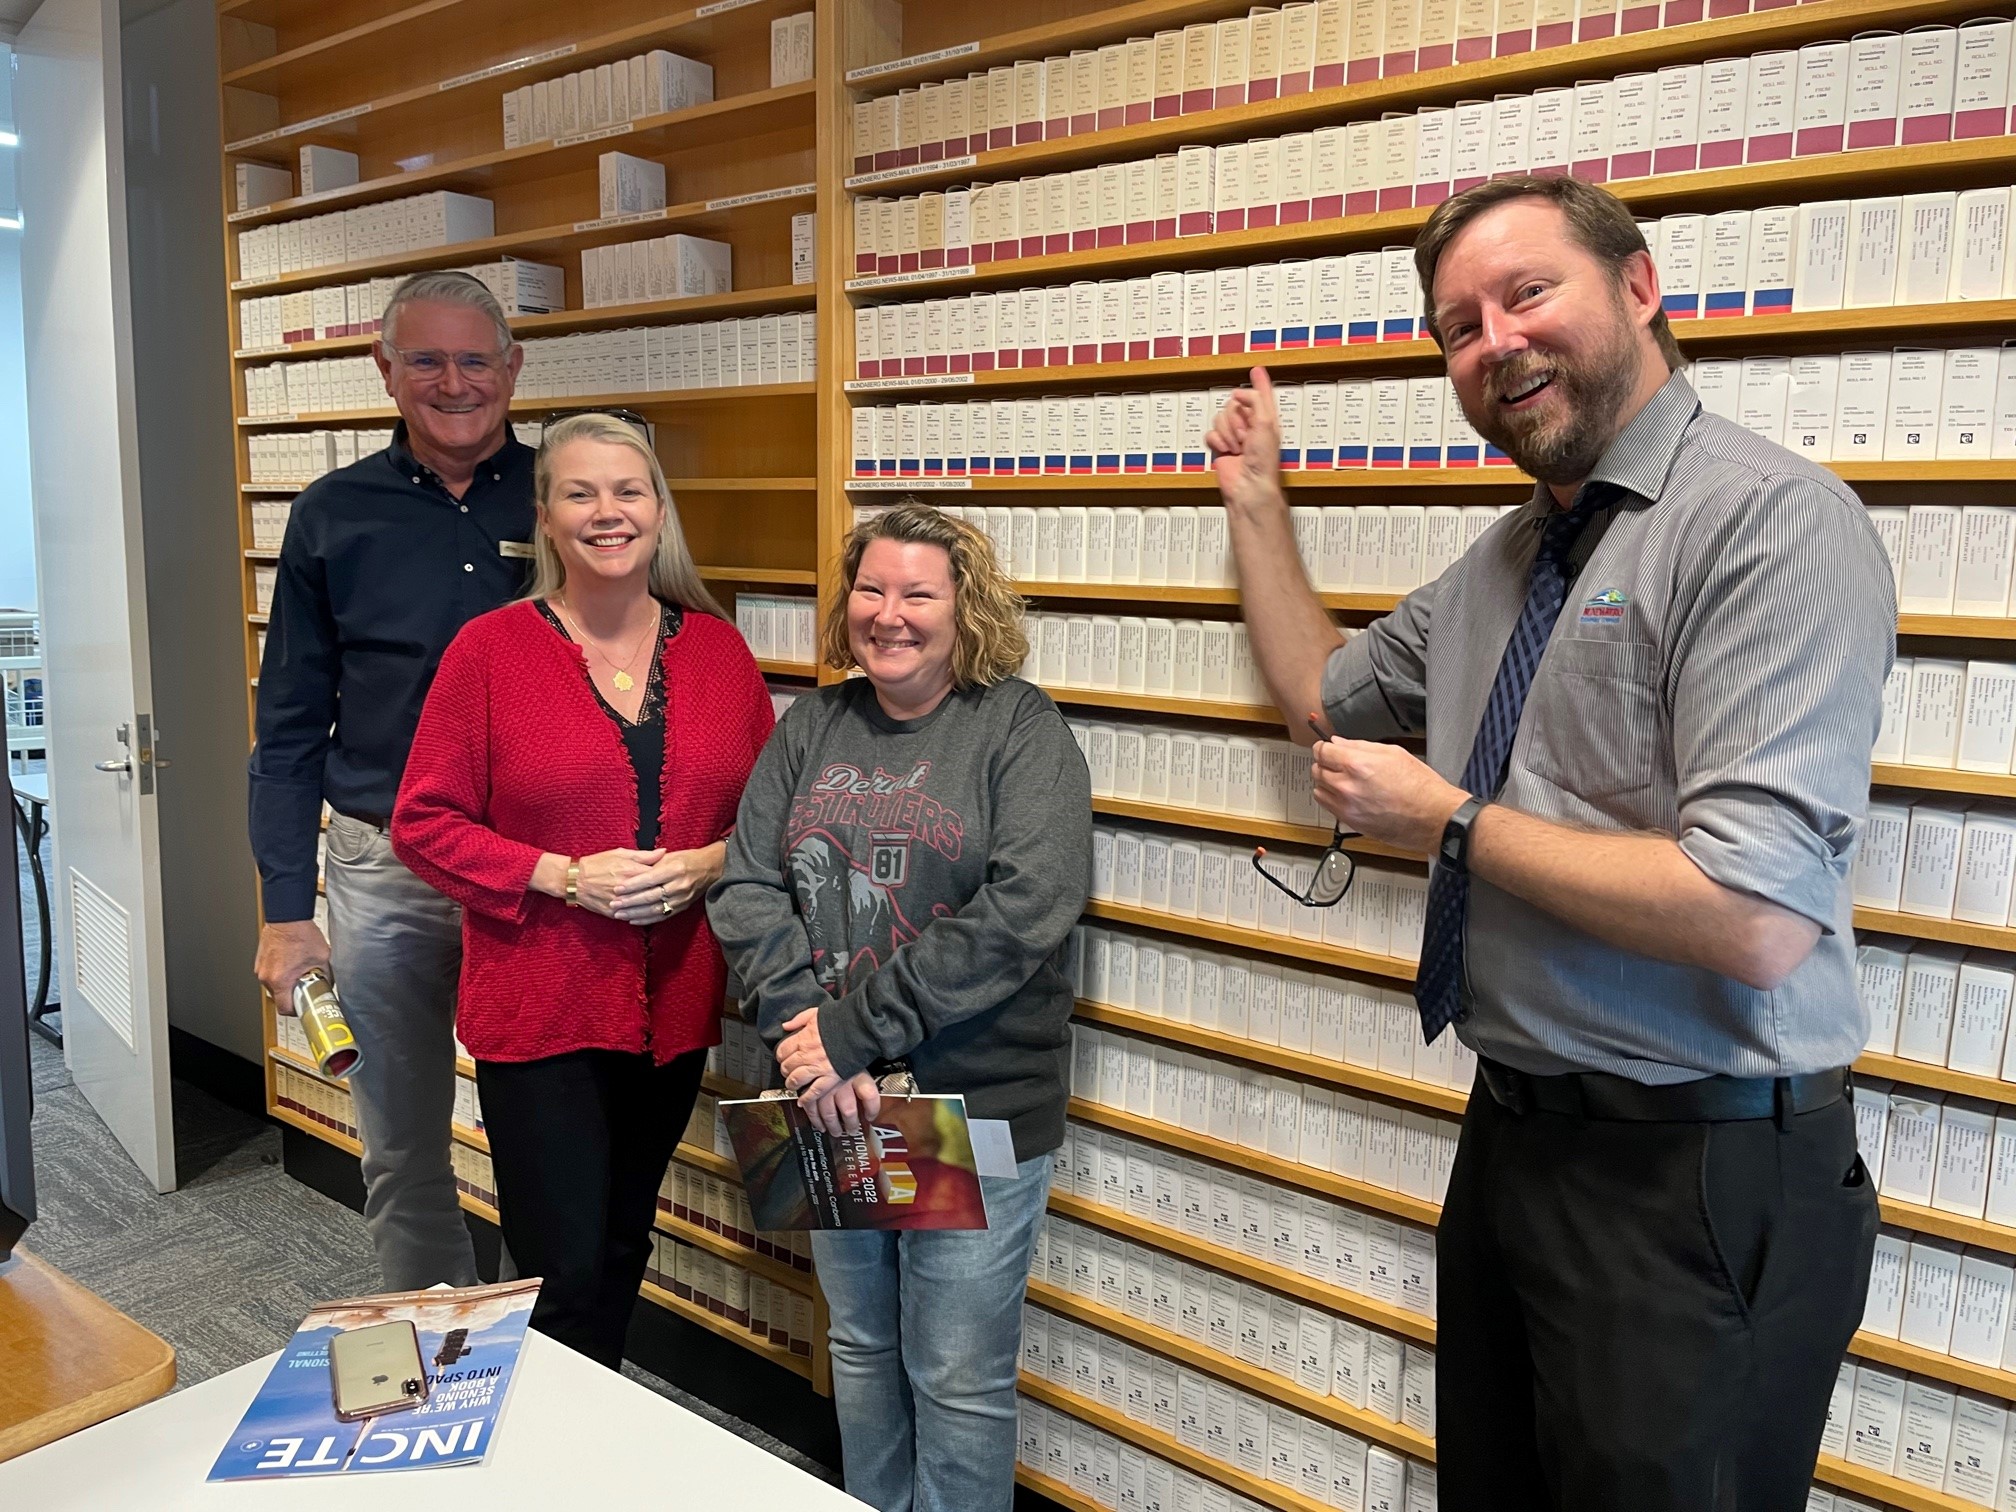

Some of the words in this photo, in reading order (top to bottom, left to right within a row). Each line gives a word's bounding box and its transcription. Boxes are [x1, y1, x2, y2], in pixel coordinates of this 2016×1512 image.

[850, 66, 882, 78] BUNDABERG
[884, 60, 912, 72] NEWS-MAIL
[850, 174, 881, 186] BUNDABERG
[882, 168, 910, 180] NEWS-MAIL
[850, 277, 882, 288] BUNDABERG
[882, 275, 910, 284] NEWS-MAIL
[850, 380, 882, 388] BUNDABERG
[882, 379, 910, 388] NEWS-MAIL
[911, 378, 938, 386] 01/01/2000
[788, 789, 963, 862] ESTROYERS
[875, 848, 902, 880] 81
[840, 1131, 864, 1204] ONFERENCE
[814, 1132, 828, 1170] Convention
[829, 1196, 842, 1227] Canberra
[862, 1177, 878, 1204] 2022
[288, 1358, 332, 1369] SIONAL
[426, 1372, 464, 1385] SPAC
[466, 1366, 502, 1380] INTO
[490, 1376, 499, 1385] A
[449, 1378, 486, 1392] BOOK
[436, 1386, 496, 1403] SENDING
[412, 1400, 456, 1415] WE'RE
[459, 1396, 492, 1410] WHY
